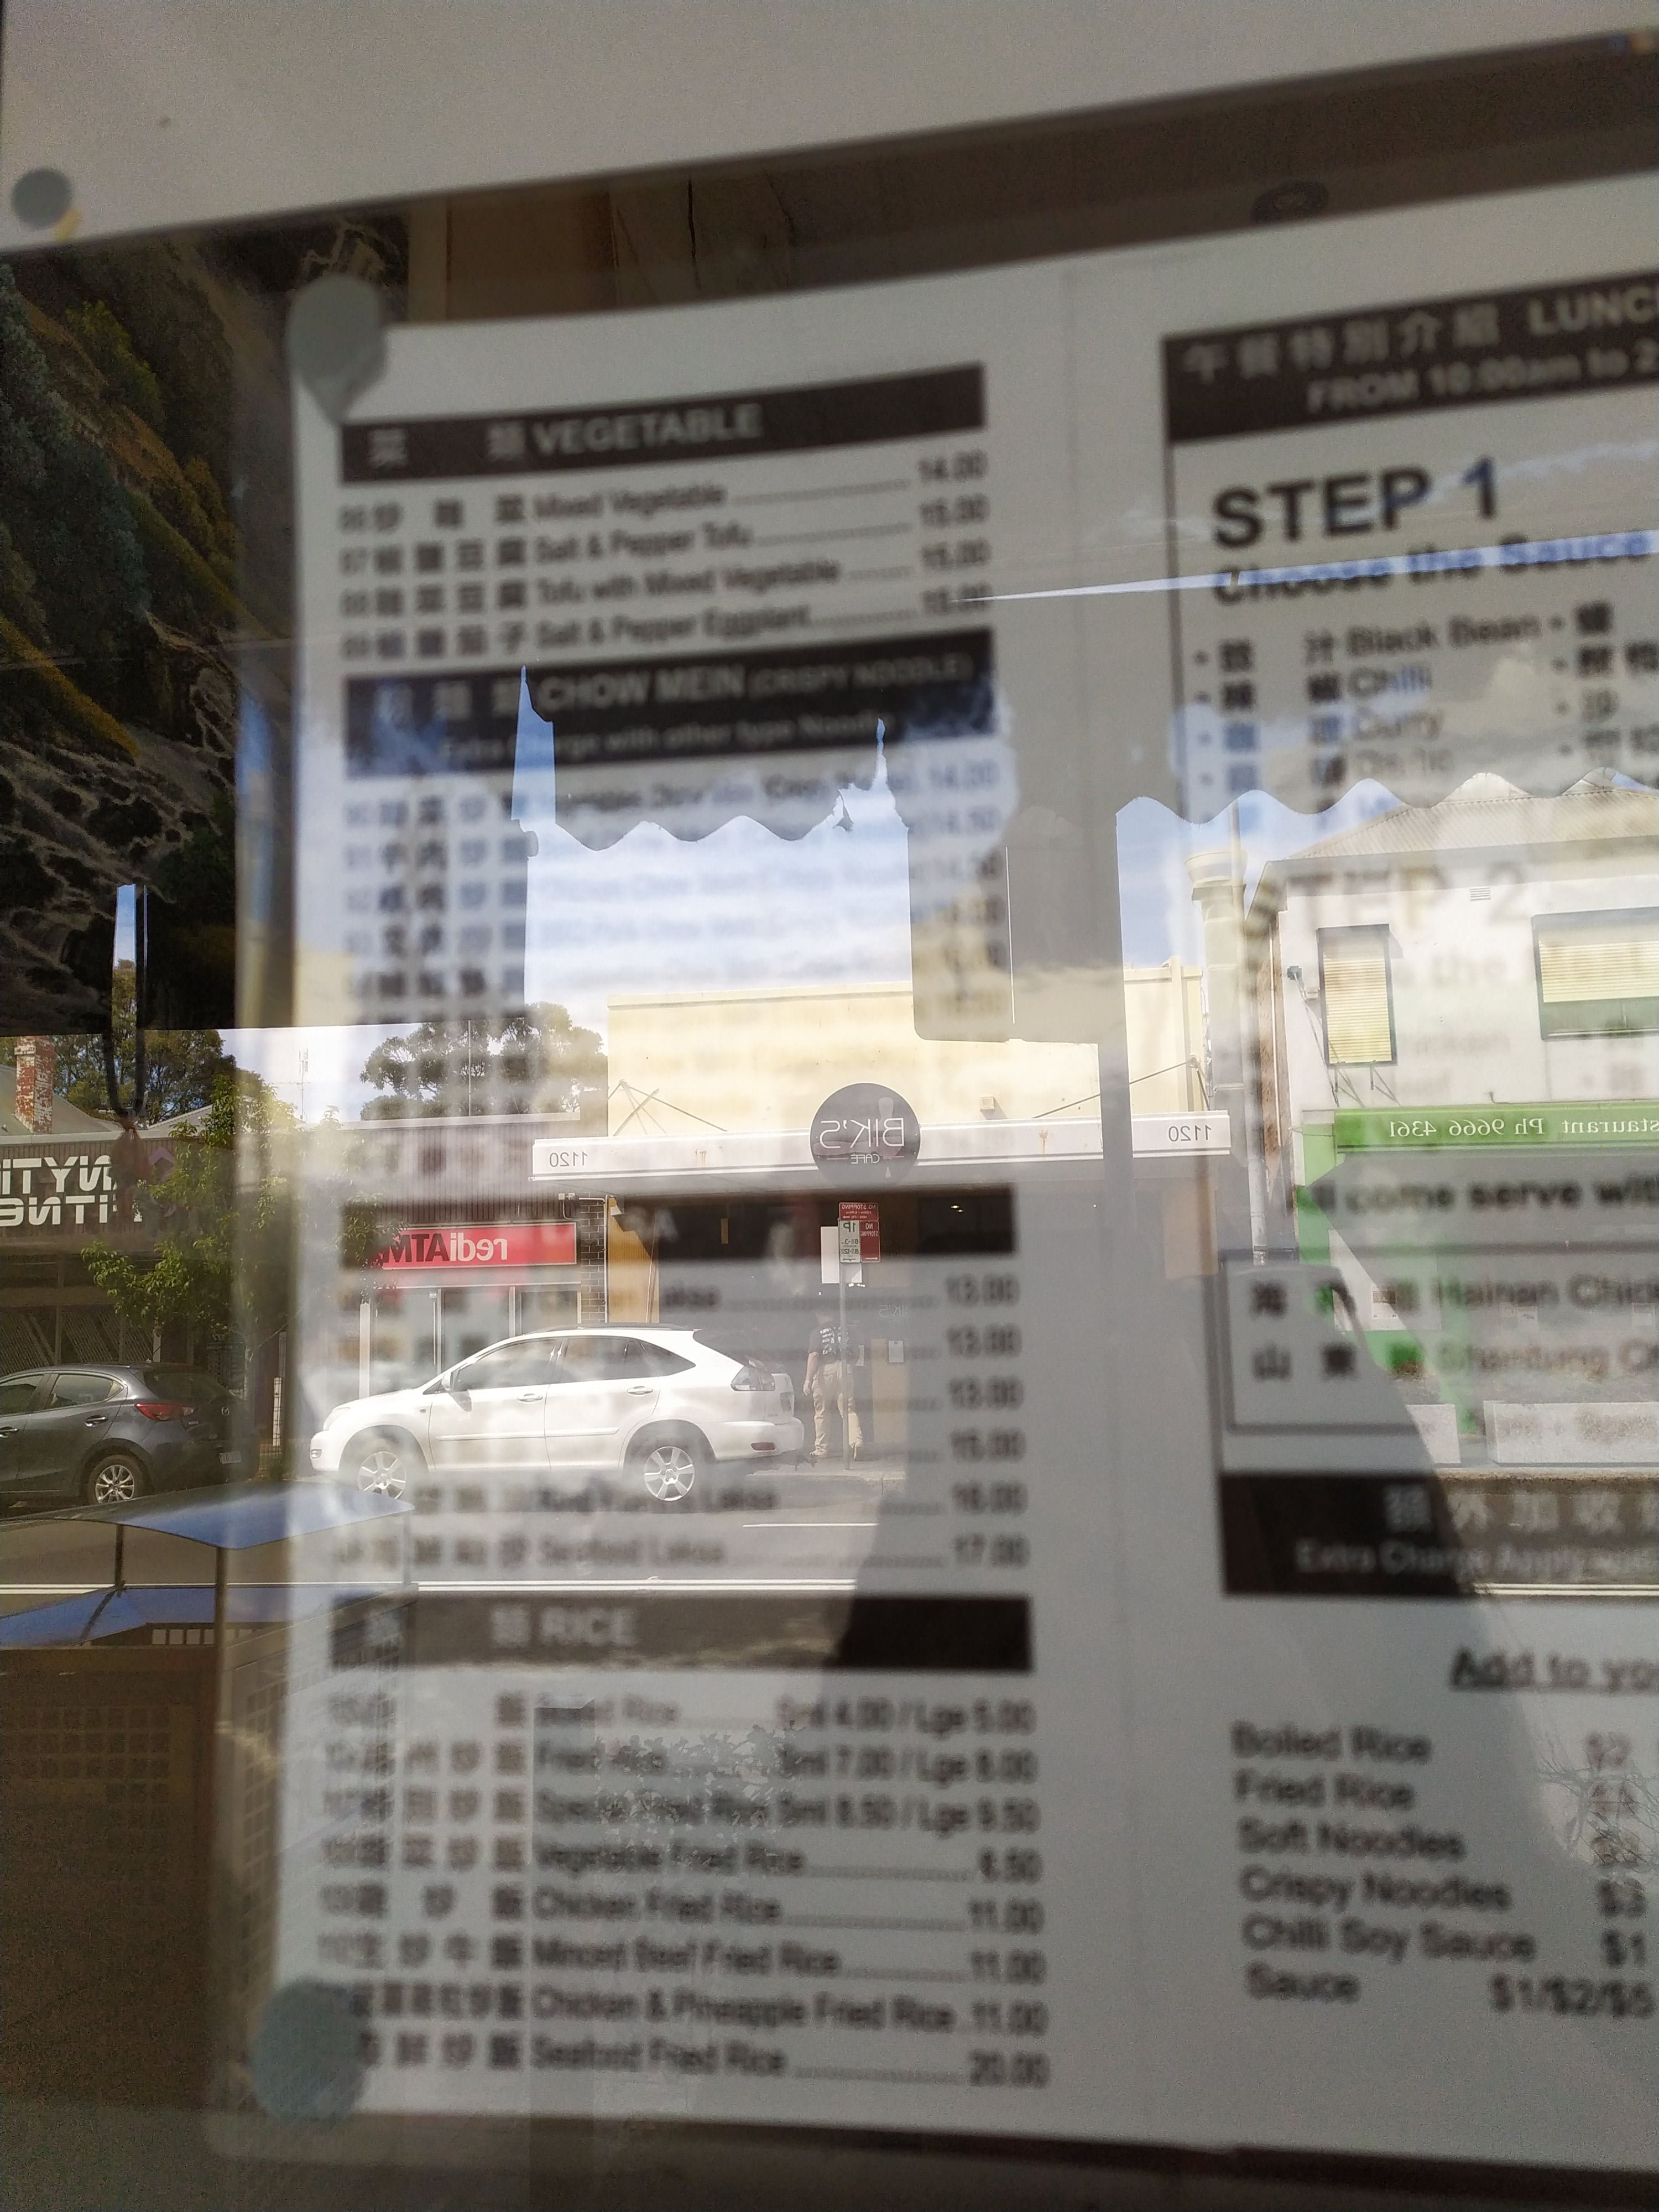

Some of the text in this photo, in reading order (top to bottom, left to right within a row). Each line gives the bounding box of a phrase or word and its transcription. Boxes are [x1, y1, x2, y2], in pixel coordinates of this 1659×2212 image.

[1306, 372, 1420, 413] FROM
[531, 402, 764, 455] VEGETABLE
[610, 483, 728, 517] Vegetable
[1212, 454, 1498, 549] STEP 1
[1345, 619, 1434, 658] Black
[535, 670, 650, 714] CHOW
[655, 664, 745, 702] MEIN
[1469, 1180, 1580, 1210] serve
[540, 1606, 640, 1648] RICE
[1448, 1647, 1535, 1692] Add
[1549, 1647, 1590, 1689] to
[1230, 1720, 1343, 1761] Boiled
[1349, 1724, 1432, 1764] Rice
[1234, 1767, 1416, 1811] Fried Rice
[1238, 1814, 1467, 1862] Soft Noodles
[721, 1888, 782, 1926] Rice
[1240, 1864, 1354, 1912] Crispy
[1363, 1869, 1513, 1911] Noodles
[779, 1939, 842, 1978] Rice
[1242, 1912, 1329, 1950] Chilli
[1339, 1915, 1410, 1964] Soy
[1420, 1921, 1537, 1962] Sauce
[1247, 1961, 1361, 2004] Sauce
[725, 2039, 786, 2077] Rice
